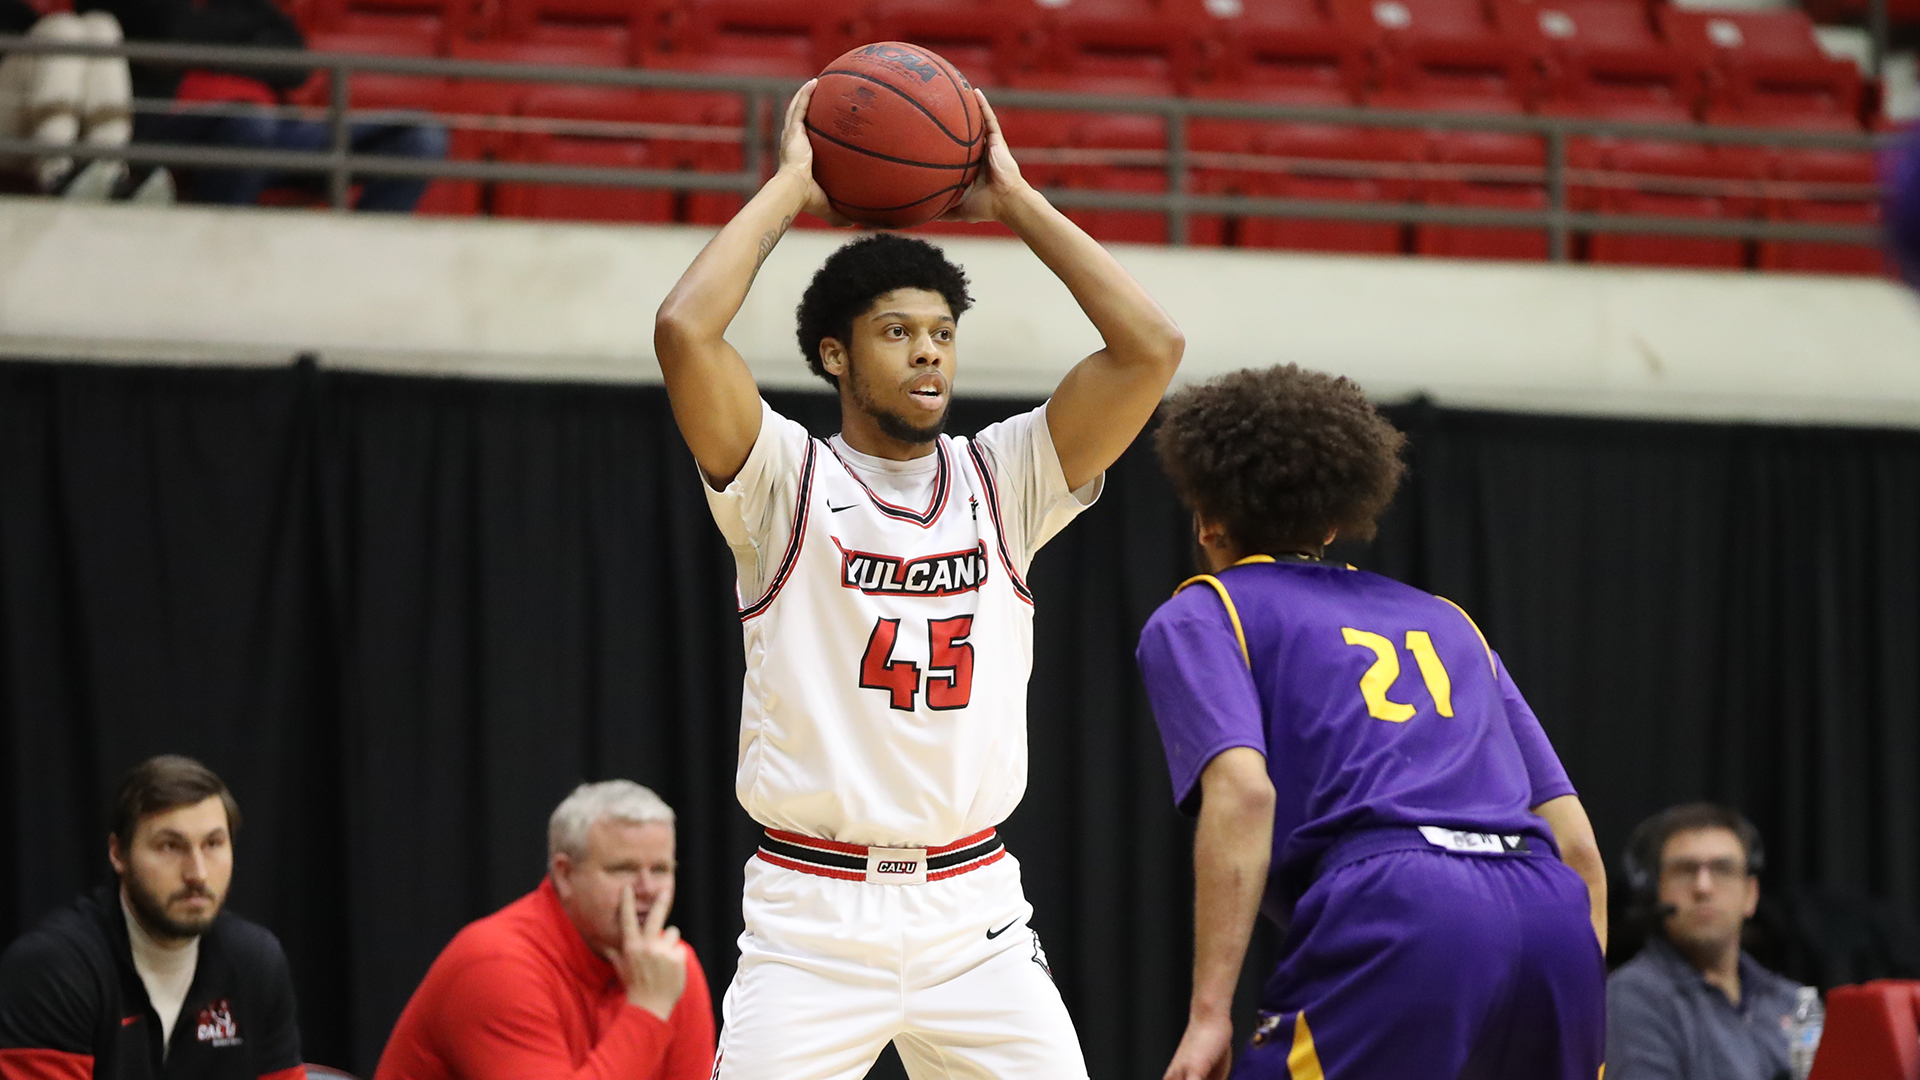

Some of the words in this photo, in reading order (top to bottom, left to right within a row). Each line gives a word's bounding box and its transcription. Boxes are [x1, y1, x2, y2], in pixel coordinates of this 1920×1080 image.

[855, 45, 938, 83] NCAA
[859, 614, 975, 712] 45
[1341, 627, 1455, 723] 21
